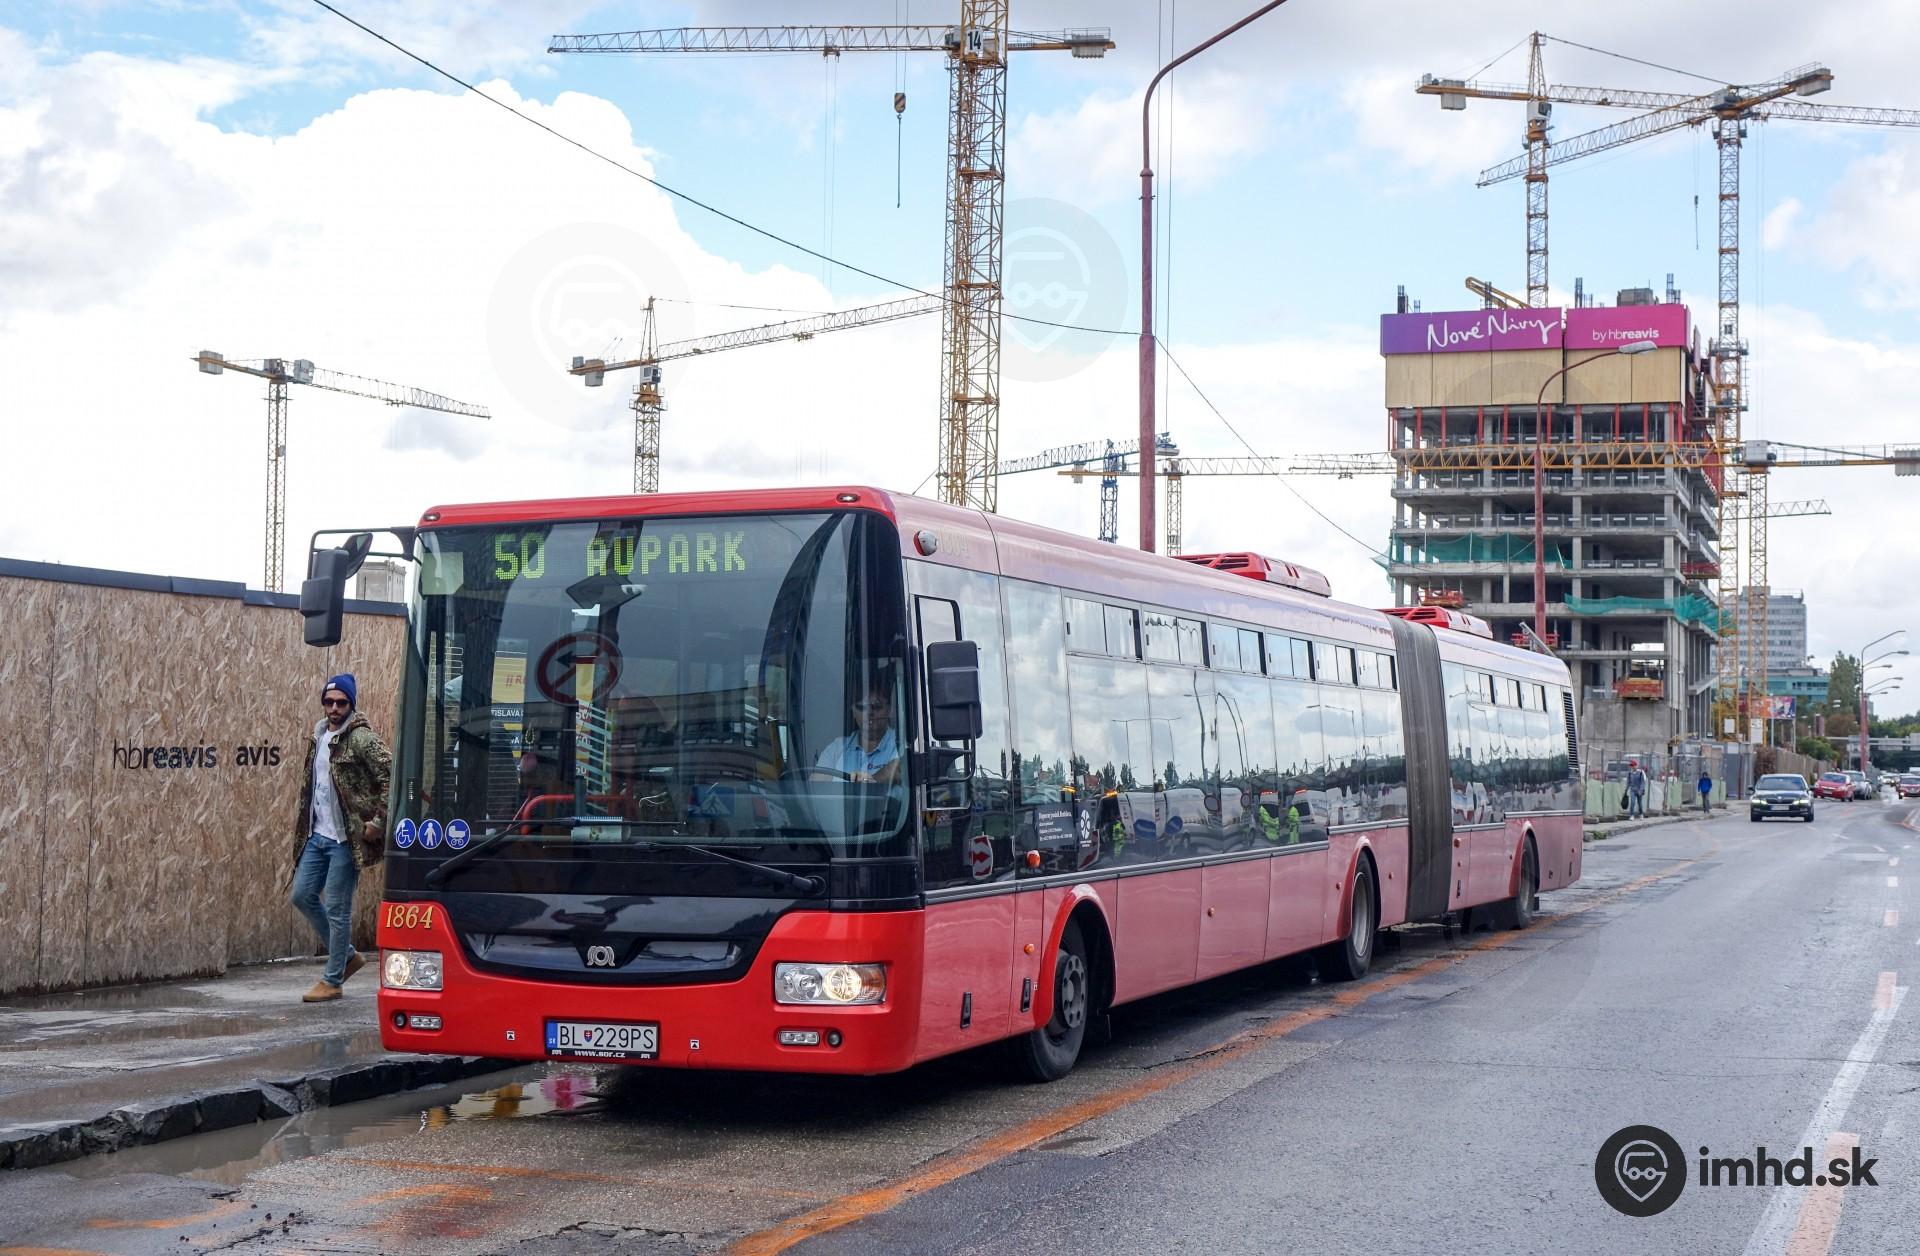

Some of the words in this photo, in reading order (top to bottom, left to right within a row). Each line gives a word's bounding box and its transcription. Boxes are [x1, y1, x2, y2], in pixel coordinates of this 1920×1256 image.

[968, 31, 981, 50] 14
[1427, 319, 1485, 351] Nové
[1488, 310, 1559, 345] Nivy
[1592, 328, 1608, 342] by
[1609, 327, 1660, 341] hbreavis
[495, 532, 545, 580] 50
[586, 531, 746, 577] AUPARK
[113, 738, 217, 770] hbreavis
[235, 739, 281, 767] avis
[386, 905, 433, 928] 1864
[560, 1025, 583, 1047] BL
[593, 1027, 654, 1050] 229PS
[574, 1049, 626, 1058] www.sor.cz
